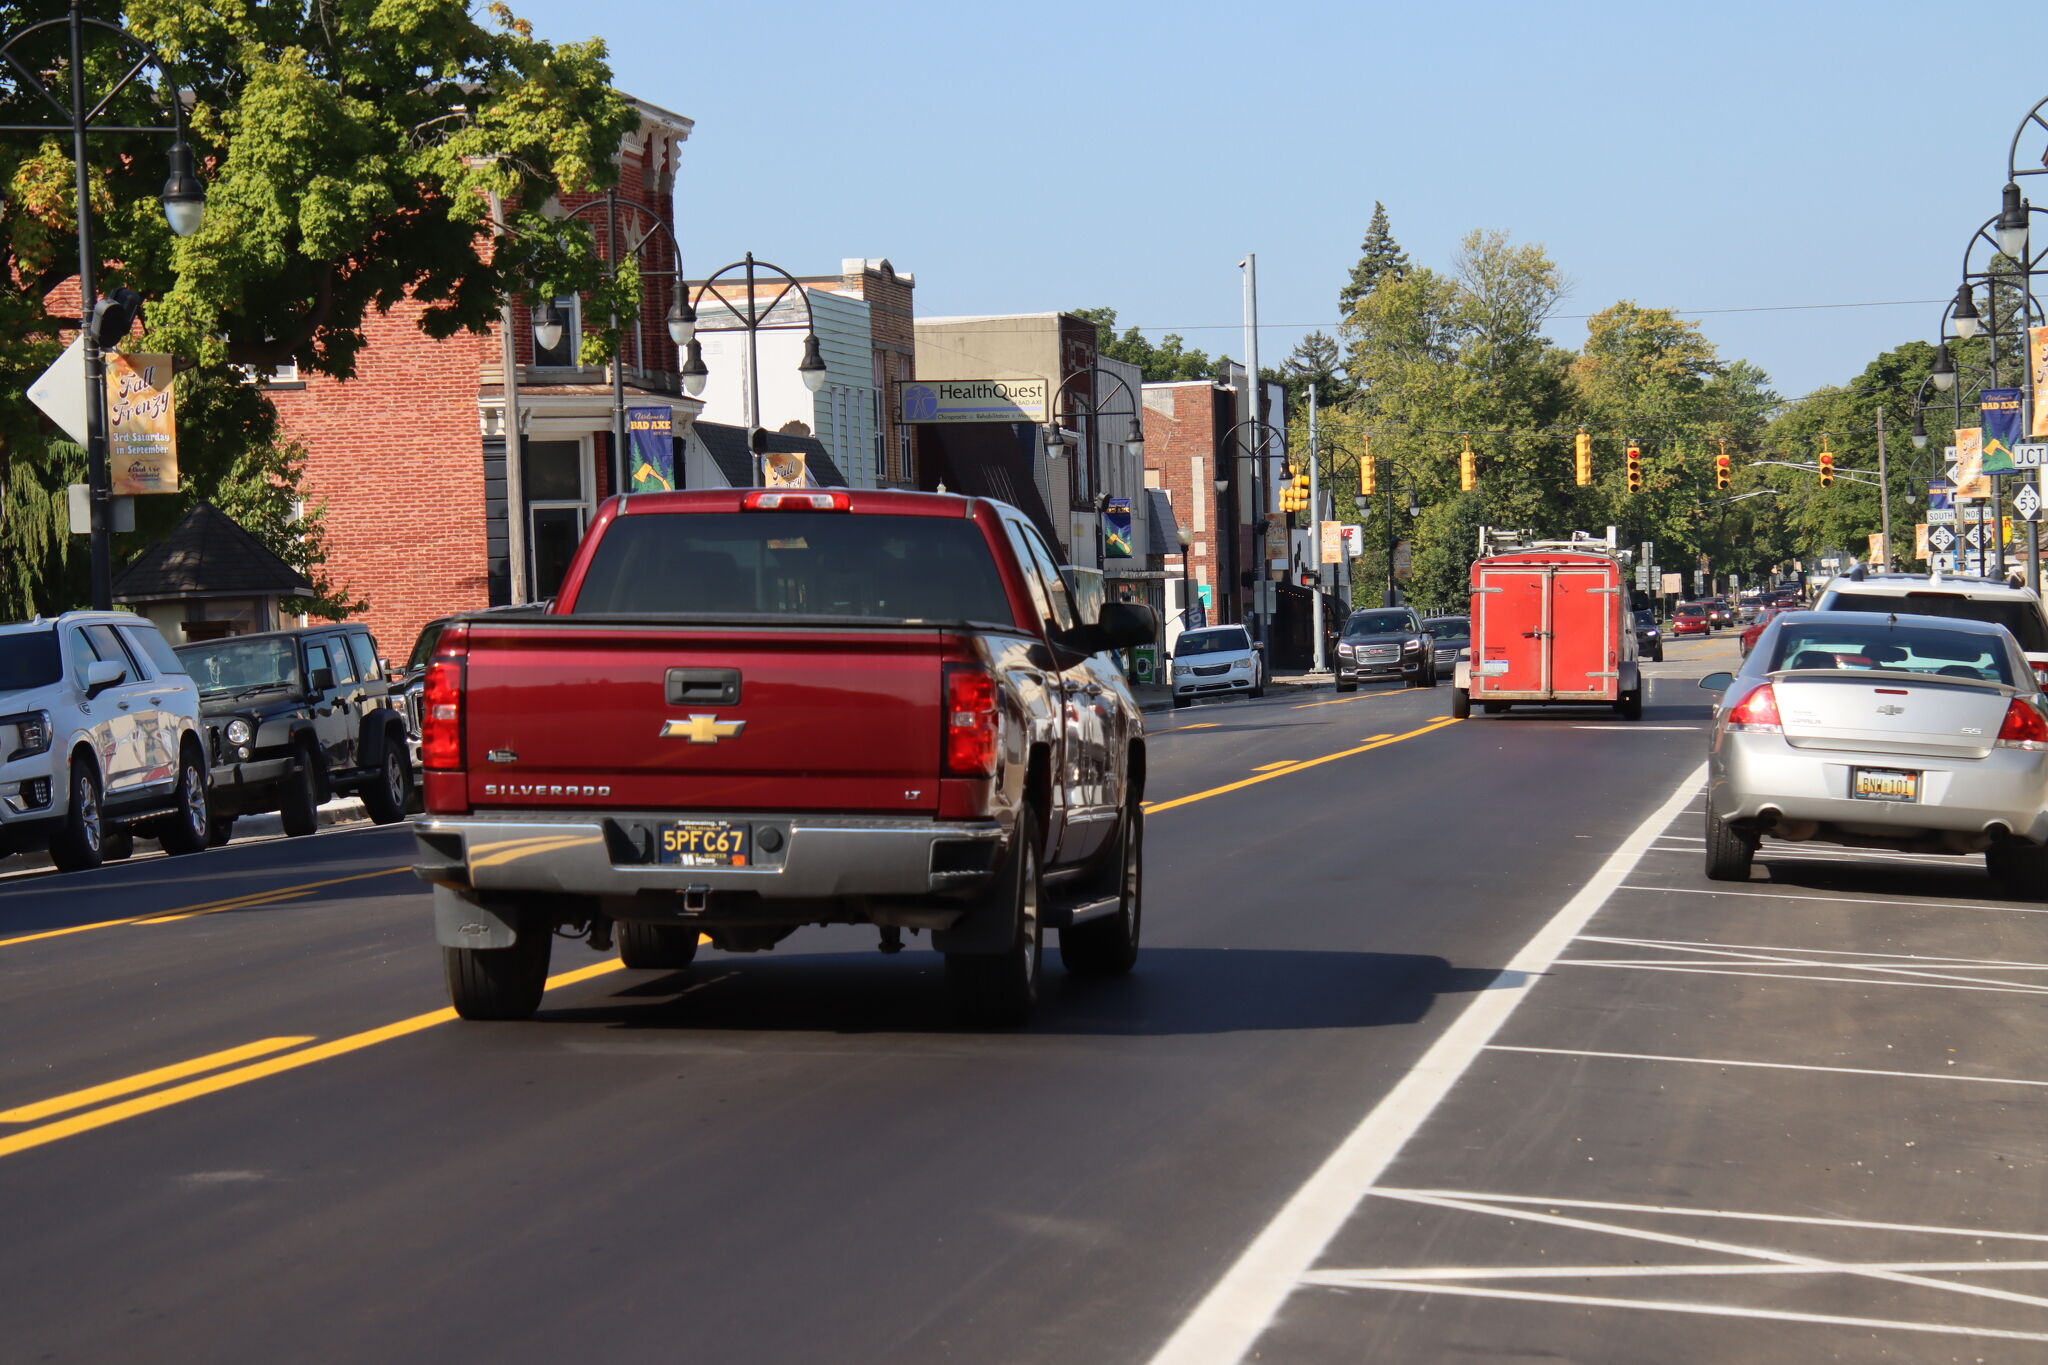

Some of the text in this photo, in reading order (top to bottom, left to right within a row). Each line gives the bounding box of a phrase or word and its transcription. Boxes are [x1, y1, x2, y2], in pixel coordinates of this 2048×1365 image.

[119, 365, 154, 399] Fall
[940, 384, 1043, 401] HealthQuest
[112, 391, 170, 426] Frenzy
[1981, 401, 2020, 410] BAD AXE
[630, 420, 671, 430] BAD AXE
[113, 432, 170, 443] 3rd Saturday
[116, 445, 169, 456] in September
[2016, 448, 2044, 465] JCT
[772, 460, 795, 481] Fall
[2020, 497, 2037, 511] 53
[1929, 512, 1953, 522] SOUTH
[1965, 510, 1990, 519] NORH
[1935, 534, 1950, 545] 53
[1961, 727, 1982, 735] SS
[485, 784, 610, 796] SILVERADO
[905, 791, 921, 800] LT
[663, 831, 743, 852] 5PFC67
